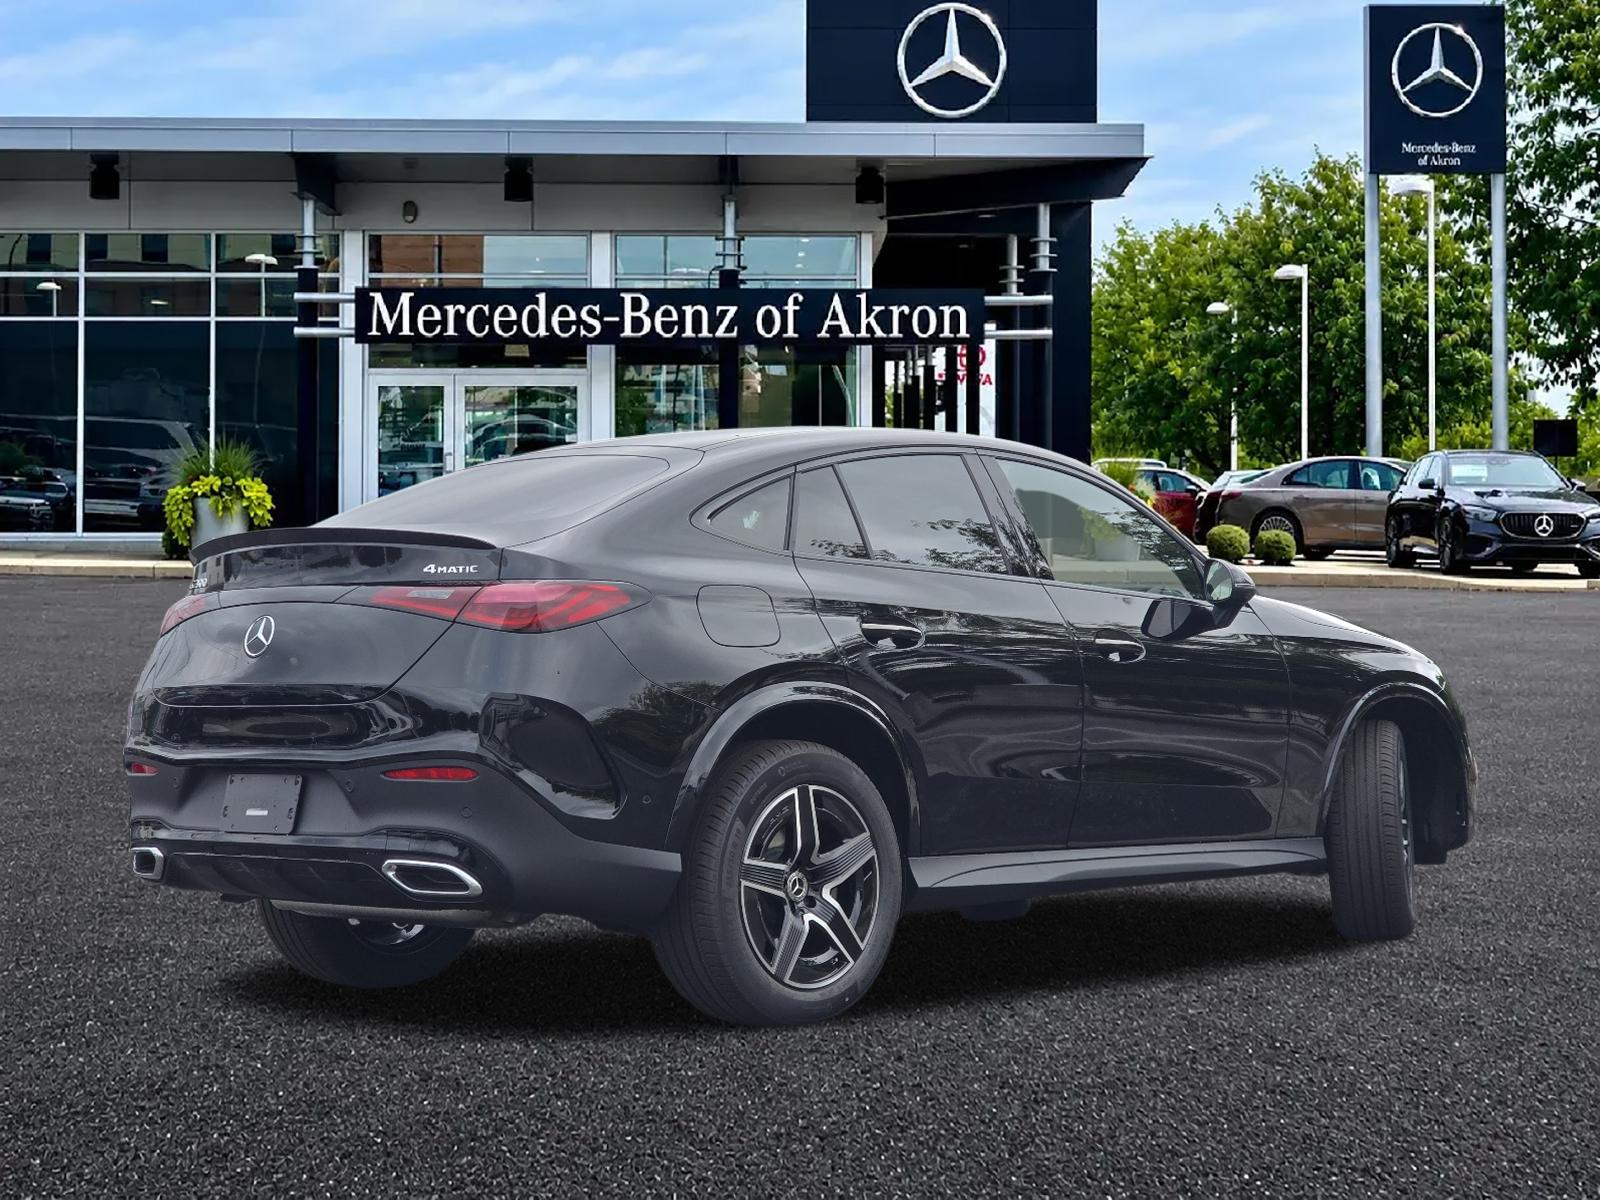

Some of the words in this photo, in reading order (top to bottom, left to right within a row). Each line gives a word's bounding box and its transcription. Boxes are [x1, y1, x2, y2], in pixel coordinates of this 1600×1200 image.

[1401, 141, 1476, 154] Mercedes-Benz
[1417, 154, 1429, 166] of
[1430, 154, 1461, 166] Akron
[366, 291, 739, 339] Mercedes-Benz
[755, 292, 804, 339] of
[816, 292, 971, 339] Akron
[423, 563, 479, 574] 4MATIC
